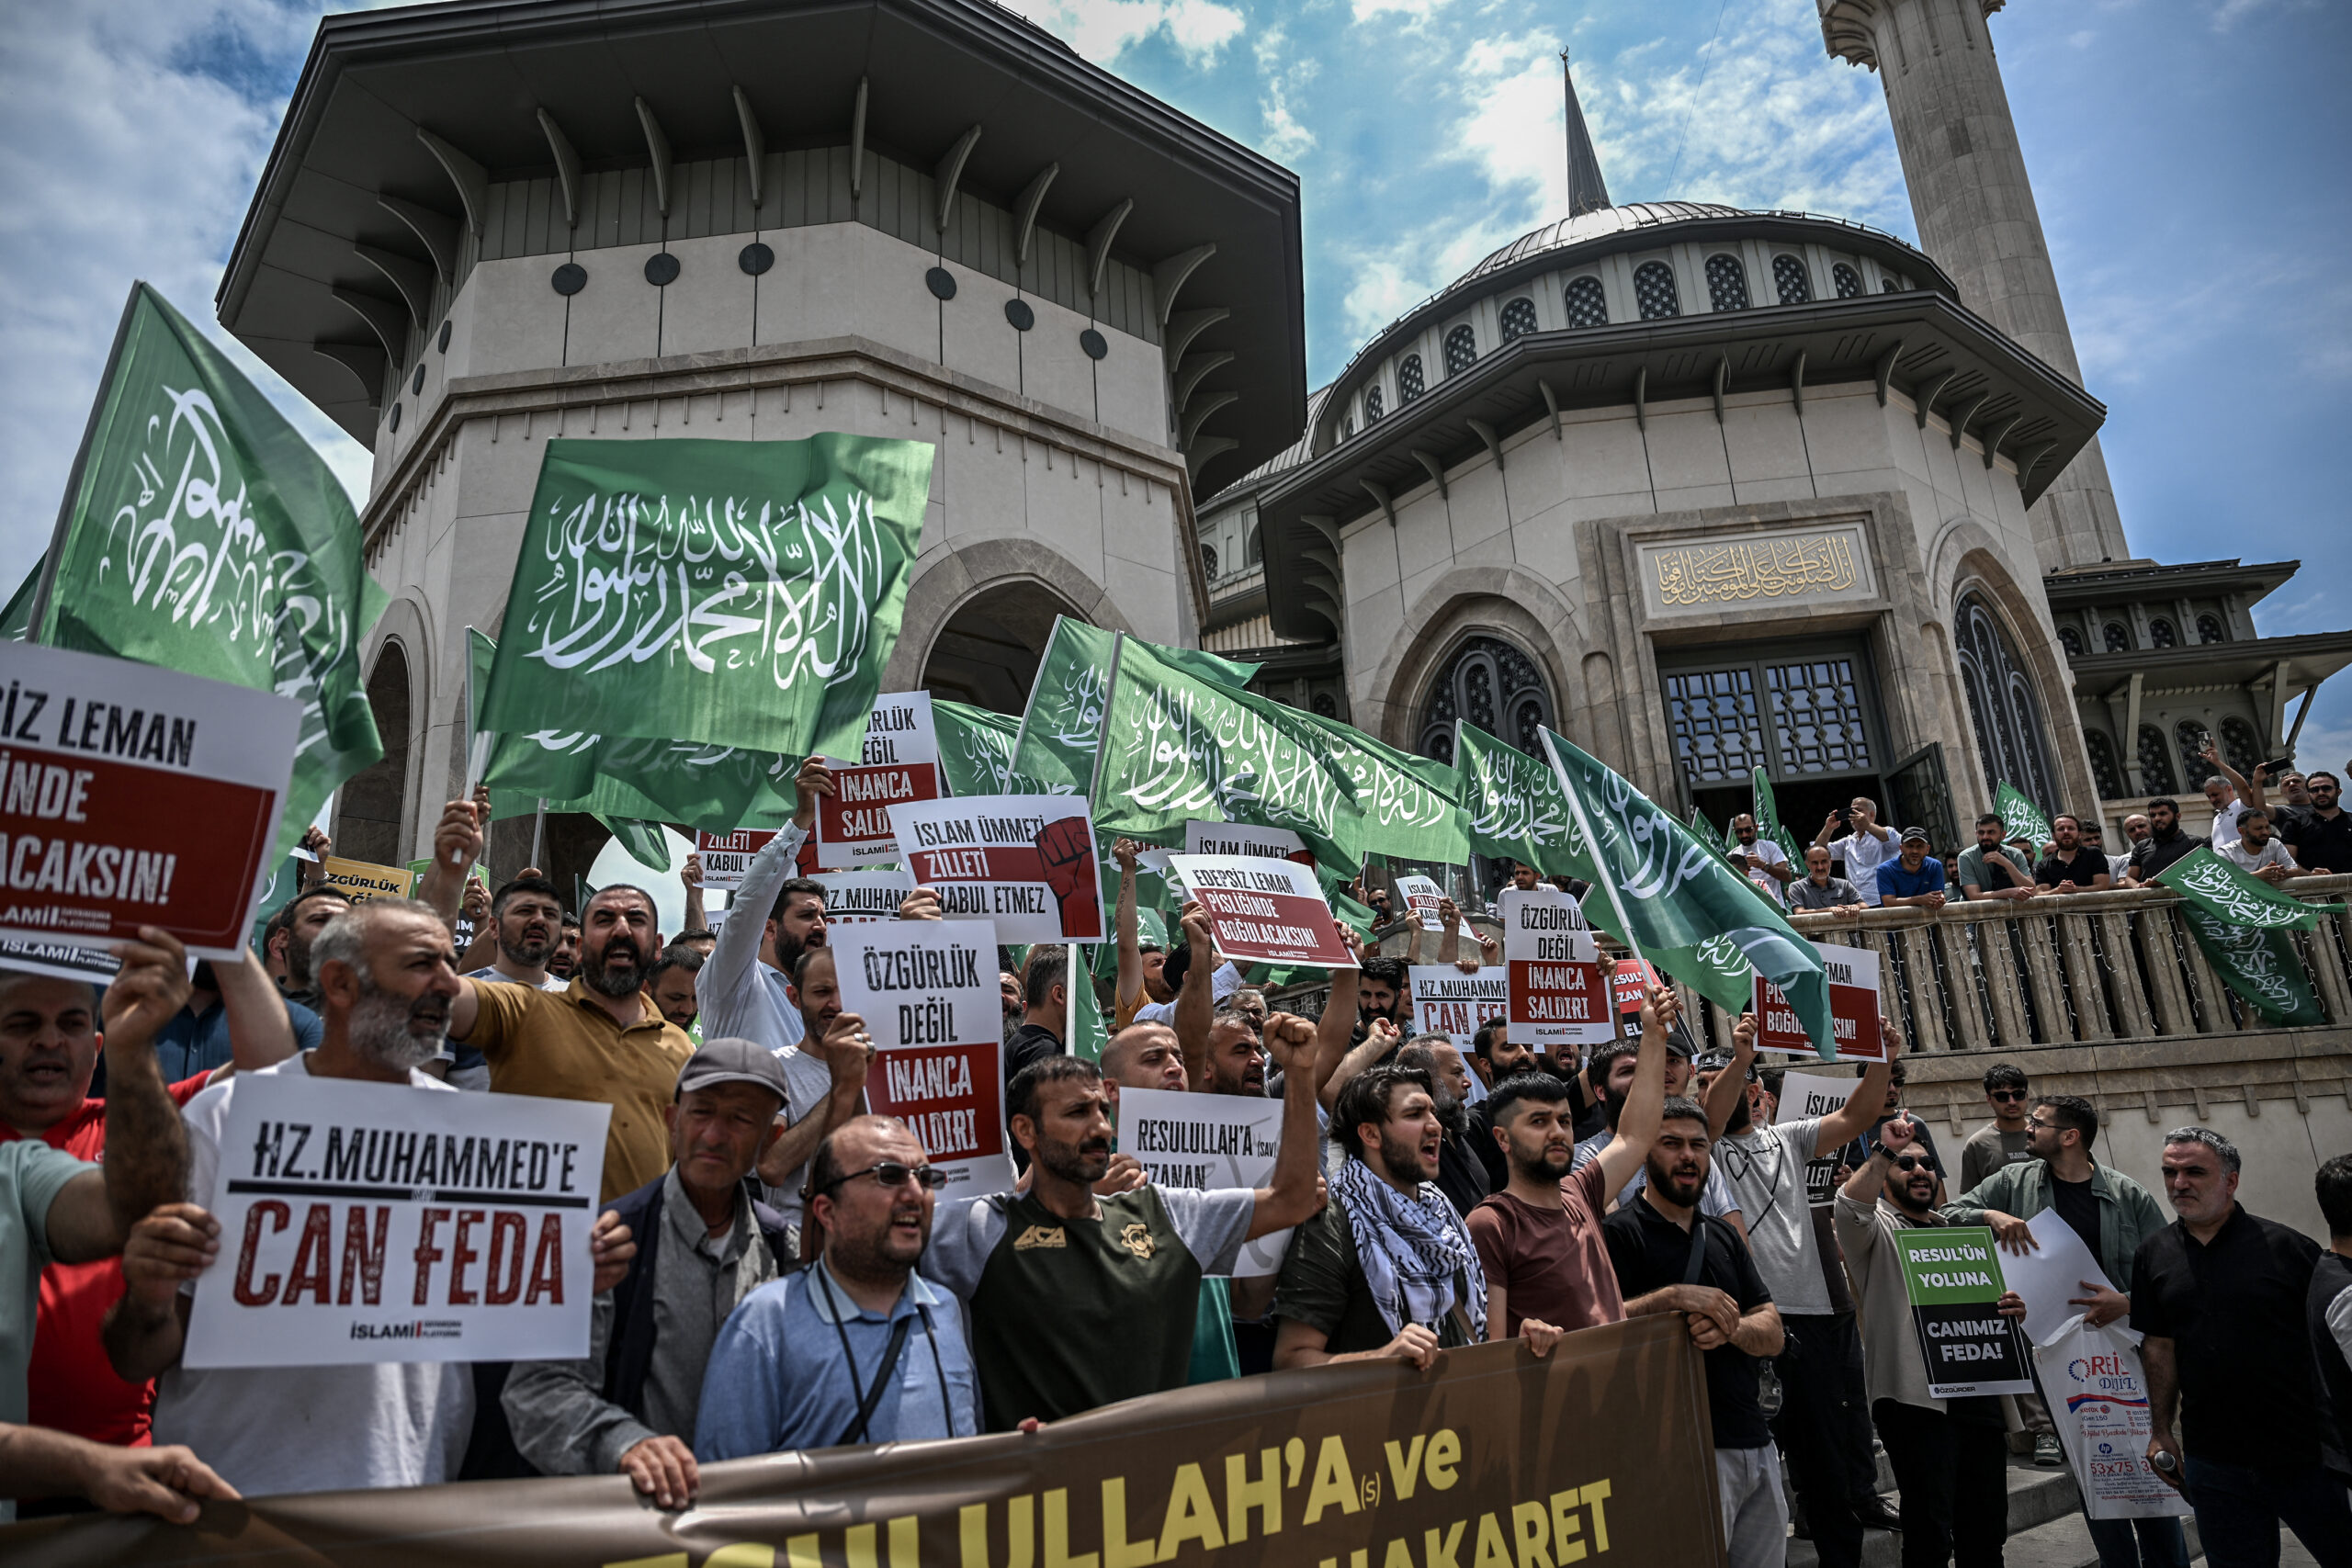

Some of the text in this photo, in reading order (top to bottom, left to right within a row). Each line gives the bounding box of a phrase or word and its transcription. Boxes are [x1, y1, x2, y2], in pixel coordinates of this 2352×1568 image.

[0, 681, 197, 767] İZ LEMAN
[840, 771, 913, 802] İNANCA
[842, 807, 895, 838] SALD
[913, 815, 1047, 847] İSLAM ÜMMETİ
[707, 853, 744, 872] KABUL
[853, 844, 885, 856] İSLAMİ
[924, 847, 990, 879] ZİLLETİ
[327, 873, 401, 894] ZGÜRLÜK
[1193, 867, 1295, 895] EDEPSİZ LEMAN
[937, 886, 1046, 915] KABUL ETMEZ
[1205, 890, 1281, 919] PİSLİĞİNDE
[1521, 904, 1590, 932] ÖZGÜRLÜ
[1217, 917, 1320, 949] BOĞULACAKSIN!
[1538, 934, 1576, 960] DEĞİL
[863, 943, 980, 991] ÖZGÜRLÜK
[1529, 964, 1586, 990] İNANCA
[1419, 980, 1506, 998] HZ.MUHAMME
[899, 996, 958, 1045] DEĞİL
[1423, 1003, 1470, 1034] CAN
[1528, 997, 1589, 1020] SALDIRI
[1536, 1027, 1562, 1035] İSLAMİ
[886, 1055, 973, 1102] İNANCA
[1805, 1091, 1846, 1116] İSLAM
[895, 1108, 978, 1156] ALDIRI
[253, 1122, 578, 1192] HZ.MUHAMMED'E
[232, 1200, 565, 1307] CAN FEDA
[1908, 1244, 1988, 1263] RESUL'ÜN
[1918, 1271, 1993, 1288] YOLUNA
[350, 1320, 414, 1340] İSLAMİ
[1927, 1319, 2008, 1338] CANIMIZ
[1940, 1343, 2004, 1362] FEDA!
[1939, 1385, 1976, 1393] ÖZGÜRDER
[1385, 1428, 1463, 1502] ve
[2090, 1461, 2133, 1473] 53x75
